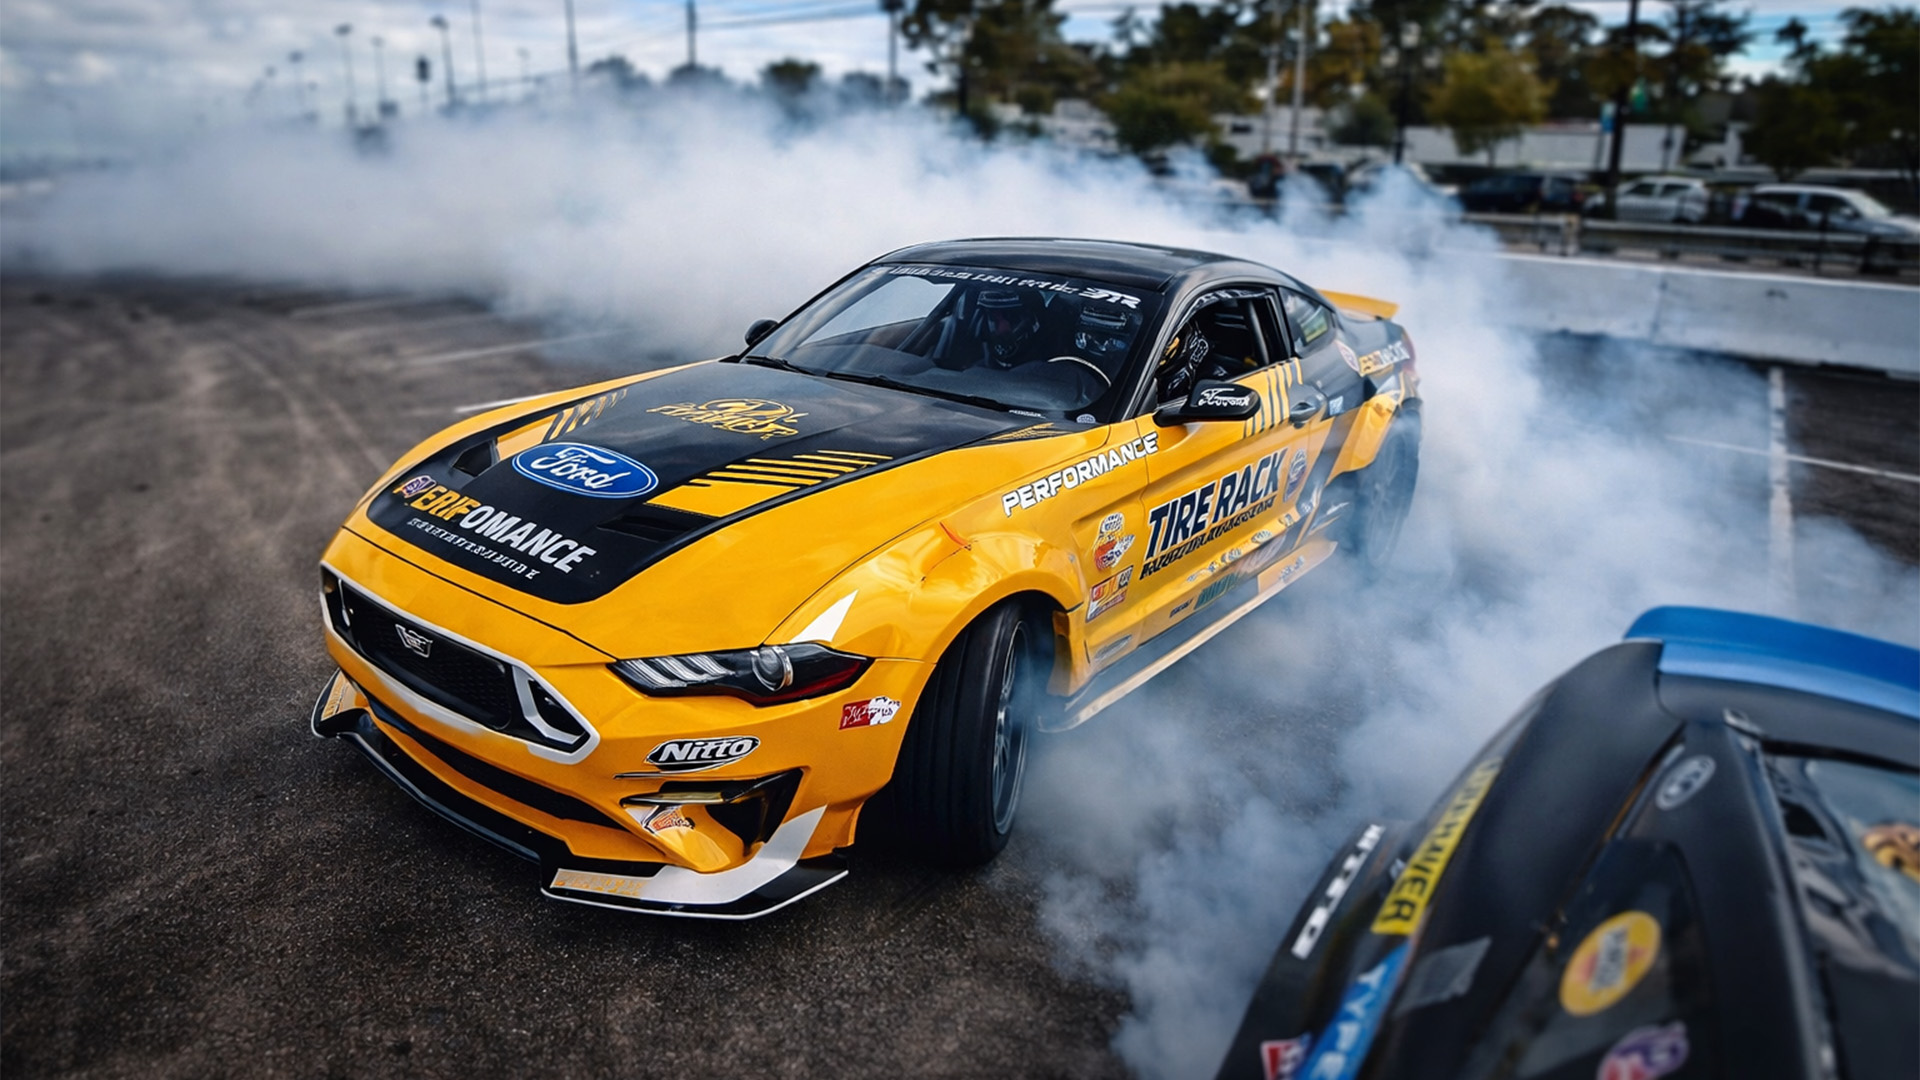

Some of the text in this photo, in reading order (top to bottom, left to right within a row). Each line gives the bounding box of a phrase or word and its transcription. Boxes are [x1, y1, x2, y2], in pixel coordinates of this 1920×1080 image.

[530, 447, 632, 489] Ford
[1001, 431, 1159, 518] PERFORMANCE
[1145, 480, 1218, 560] TIRE
[1211, 447, 1289, 525] RACK
[658, 738, 755, 762] Nitto
